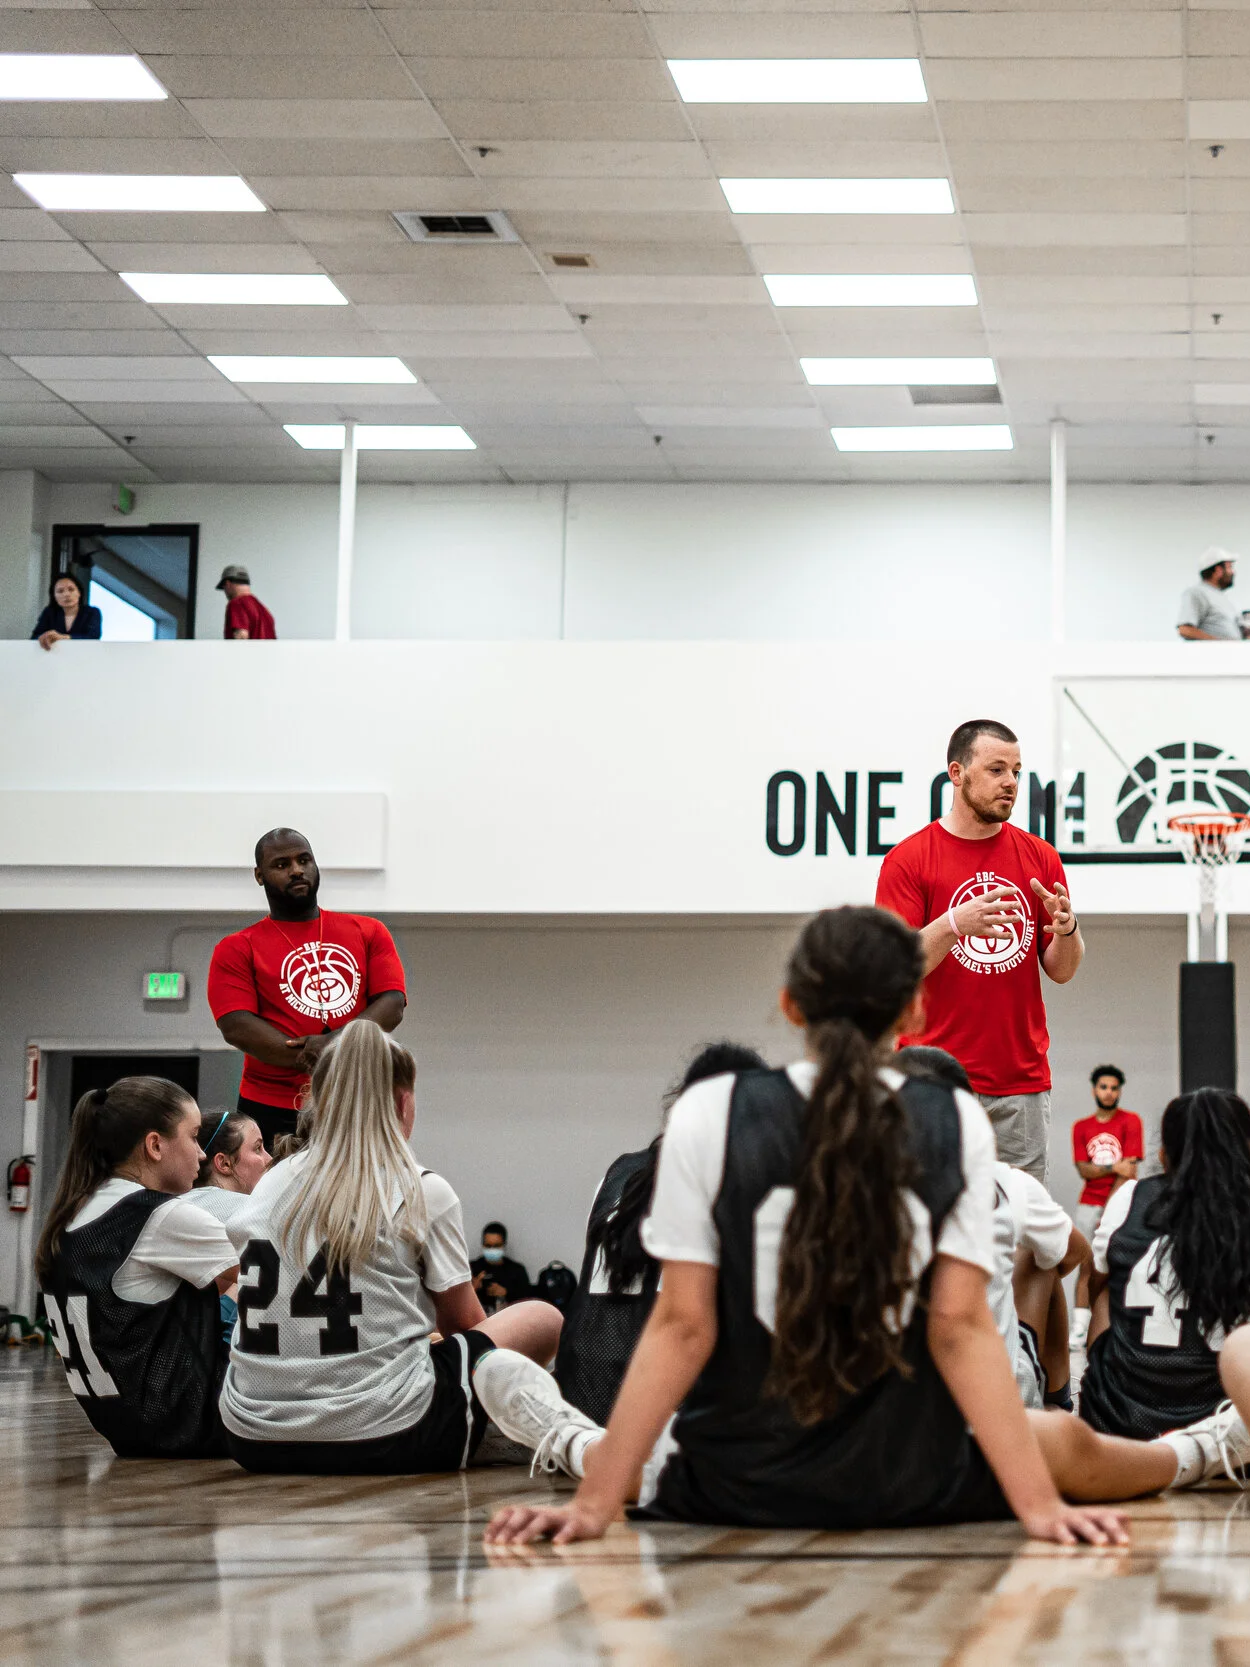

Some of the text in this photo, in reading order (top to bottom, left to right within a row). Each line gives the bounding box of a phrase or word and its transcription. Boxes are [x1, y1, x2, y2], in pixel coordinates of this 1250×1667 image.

[765, 769, 903, 857] ONE
[976, 871, 995, 882] EBC
[950, 919, 1035, 974] ICHAEL'S TOYOTA COURT
[330, 998, 357, 1019] TOYOTA
[238, 1239, 363, 1356] 24
